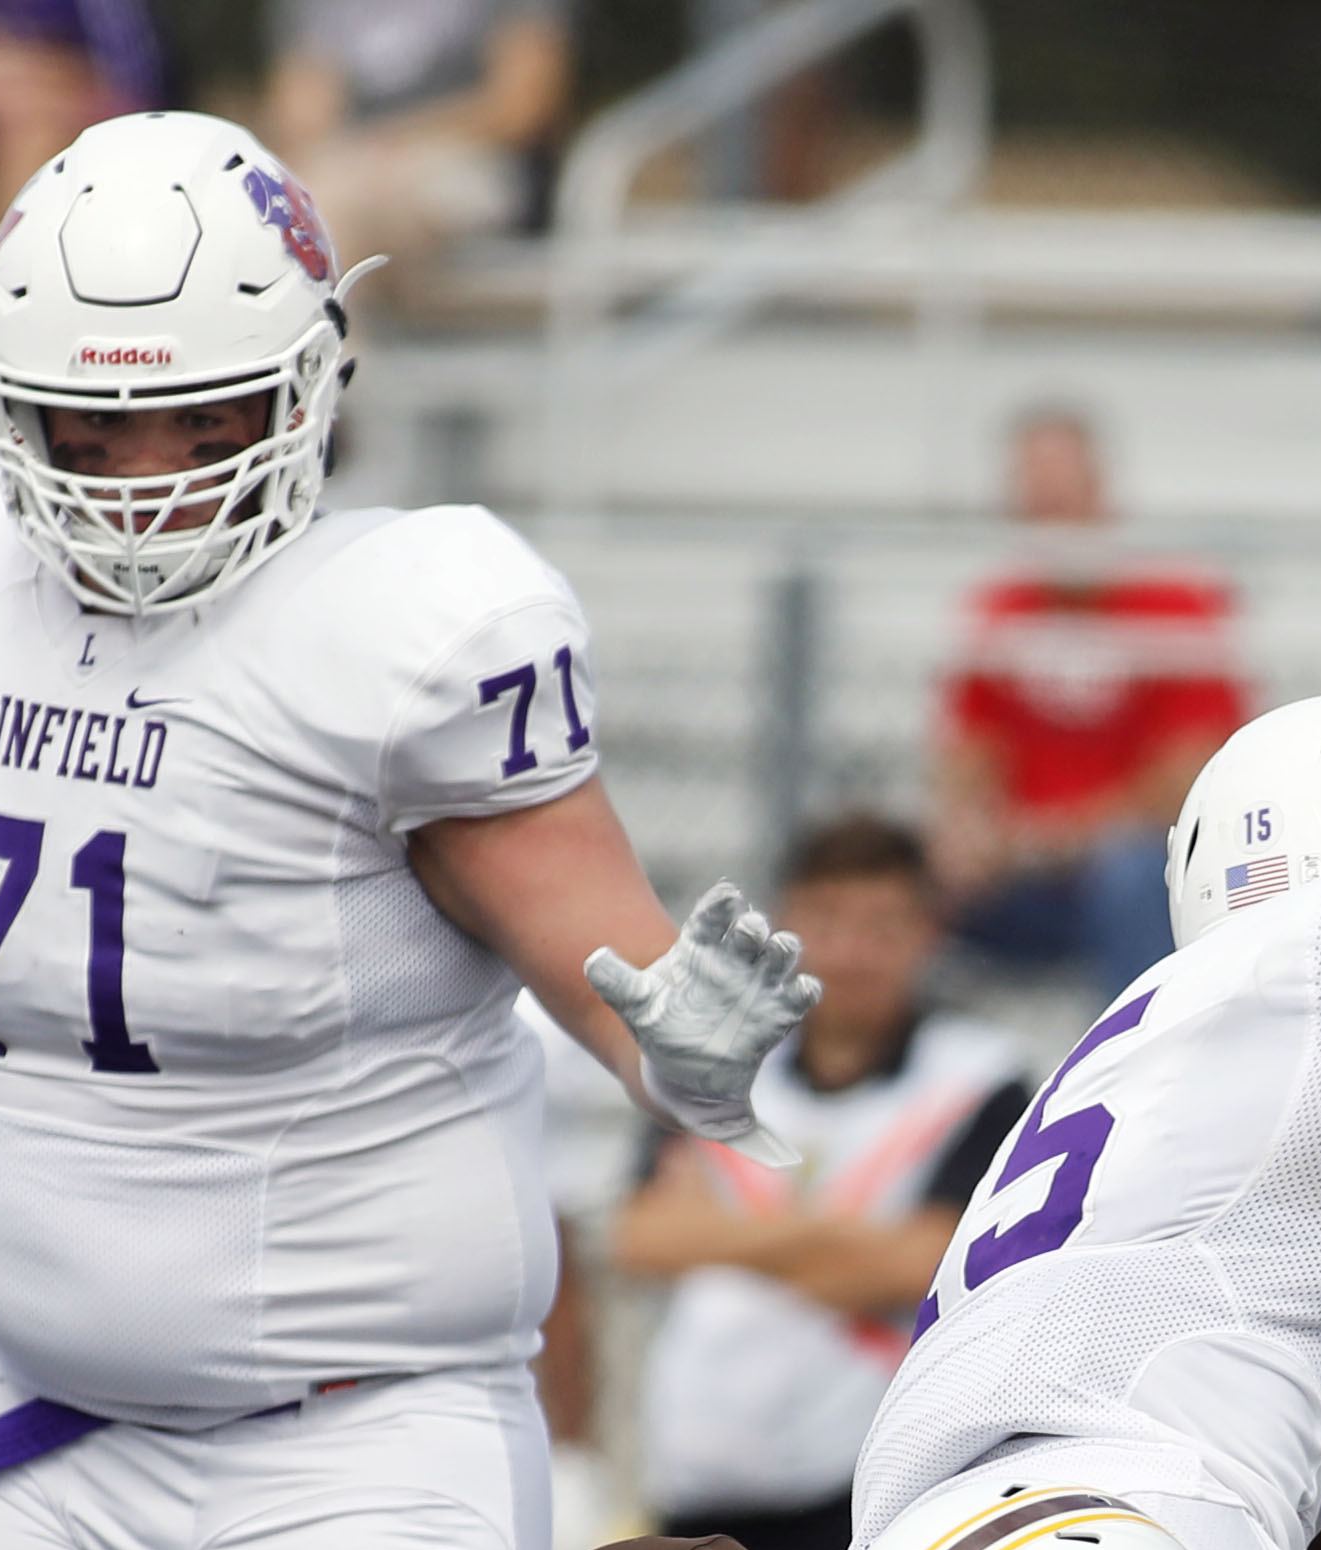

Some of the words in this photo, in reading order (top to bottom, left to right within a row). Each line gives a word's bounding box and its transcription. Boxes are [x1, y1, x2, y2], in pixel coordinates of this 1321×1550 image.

[79, 634, 96, 667] L
[479, 645, 590, 779] 71
[1244, 807, 1272, 845] 15
